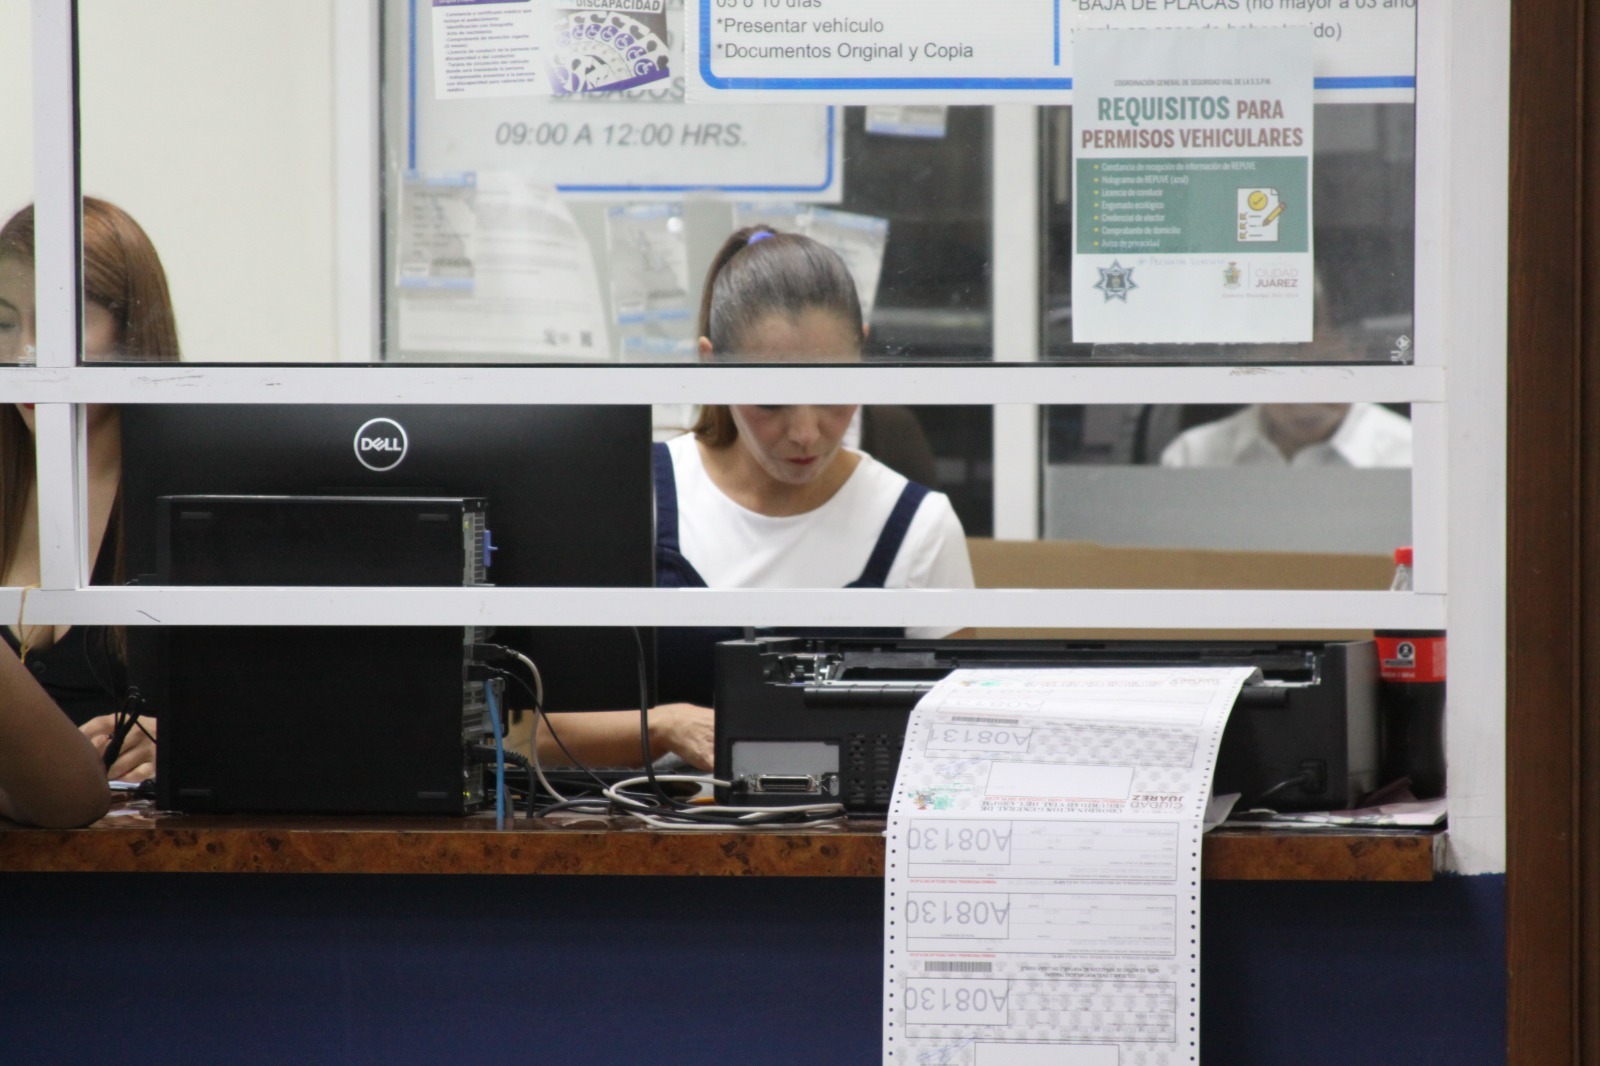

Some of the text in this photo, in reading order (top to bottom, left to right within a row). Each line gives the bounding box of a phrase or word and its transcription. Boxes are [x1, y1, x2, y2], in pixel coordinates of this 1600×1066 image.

[576, 0, 660, 10] DISCAPACIDAD
[1131, 0, 1157, 10] DE
[1164, 0, 1240, 10] PLACAS
[1246, 0, 1273, 13] (no
[1280, 0, 1332, 12] mayor
[1339, 0, 1348, 8] a
[813, 18, 884, 33] vehículo
[837, 43, 903, 61] Original
[909, 46, 918, 61] y
[924, 43, 974, 60] Copia
[1097, 96, 1284, 126] REQUISITOS PARA
[495, 122, 747, 147] 09:00 A 12:00 HRS.
[1082, 128, 1303, 148] PERMISOS VEHICULARES
[1255, 268, 1299, 278] CIUDAD
[1255, 278, 1299, 288] JUÁREZ
[361, 437, 402, 451] DELL
[928, 729, 1032, 746] A08131
[907, 827, 1013, 851] A08130
[905, 900, 1010, 925] A08130
[904, 987, 1010, 1012] A08130
